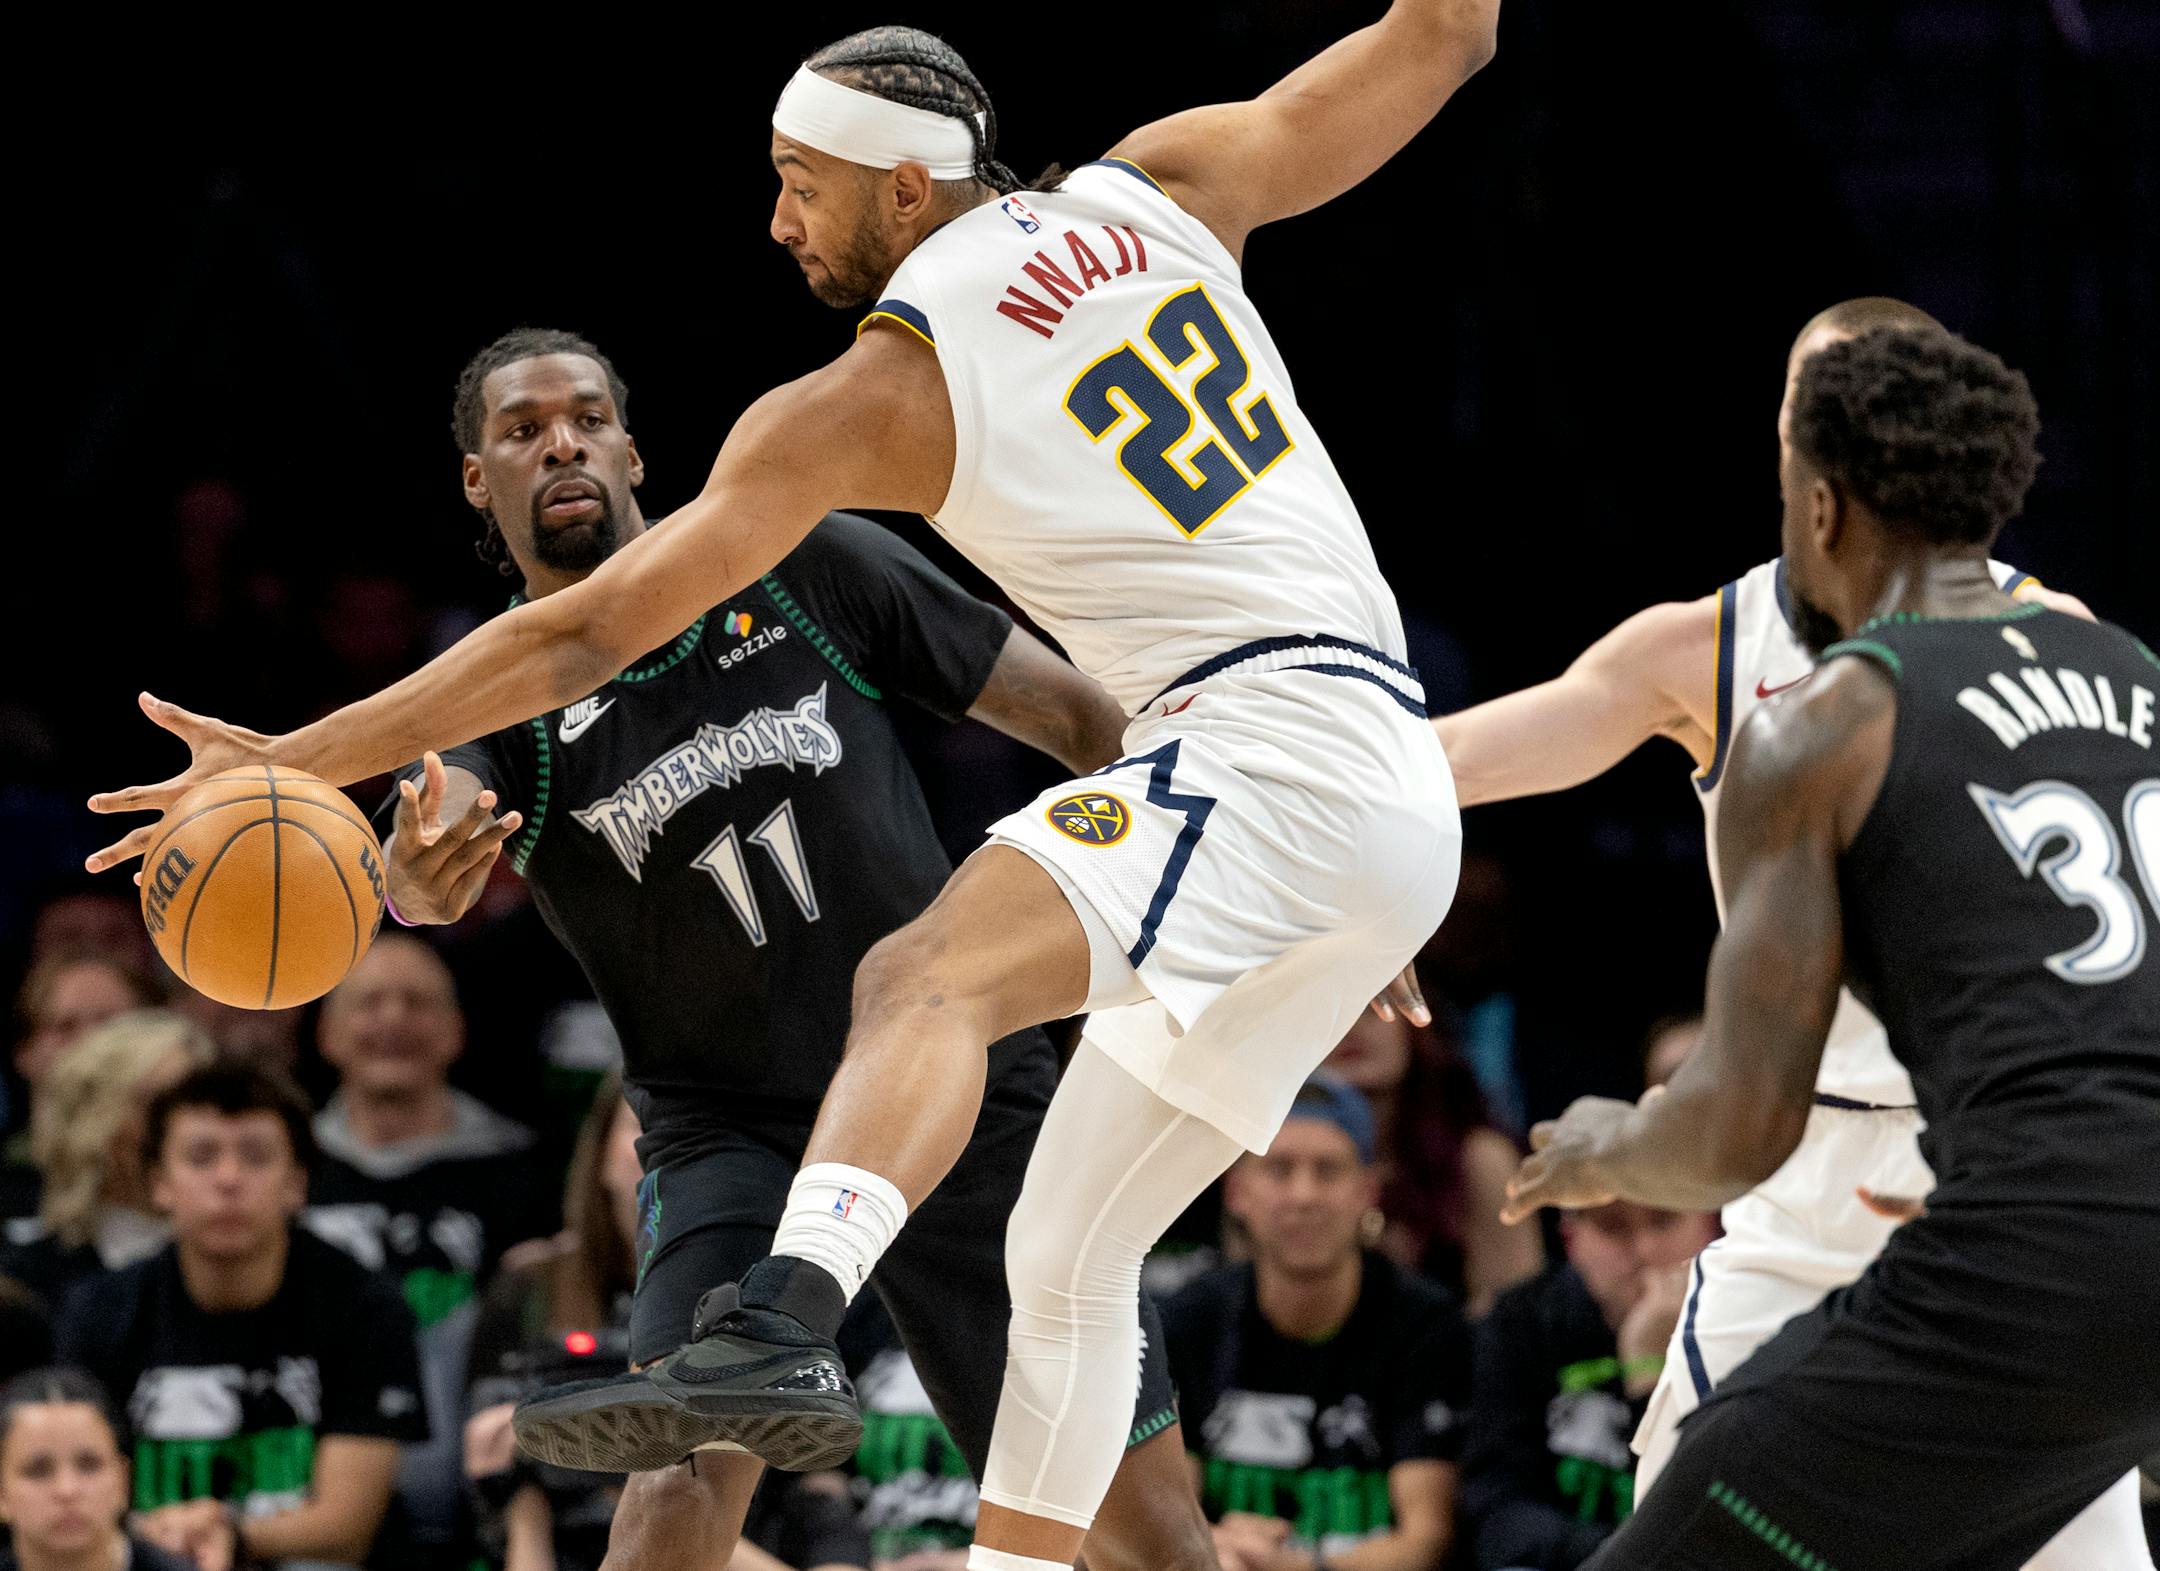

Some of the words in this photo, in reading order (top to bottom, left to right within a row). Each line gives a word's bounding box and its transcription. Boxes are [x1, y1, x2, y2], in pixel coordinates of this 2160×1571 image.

[996, 224, 1148, 340] NNAJI
[1061, 280, 1296, 541] 22
[718, 623, 788, 670] sezzle
[564, 695, 599, 728] NIKE
[1956, 667, 2155, 751] RANDLE
[689, 798, 820, 947] 11
[1966, 778, 2160, 986] 3
